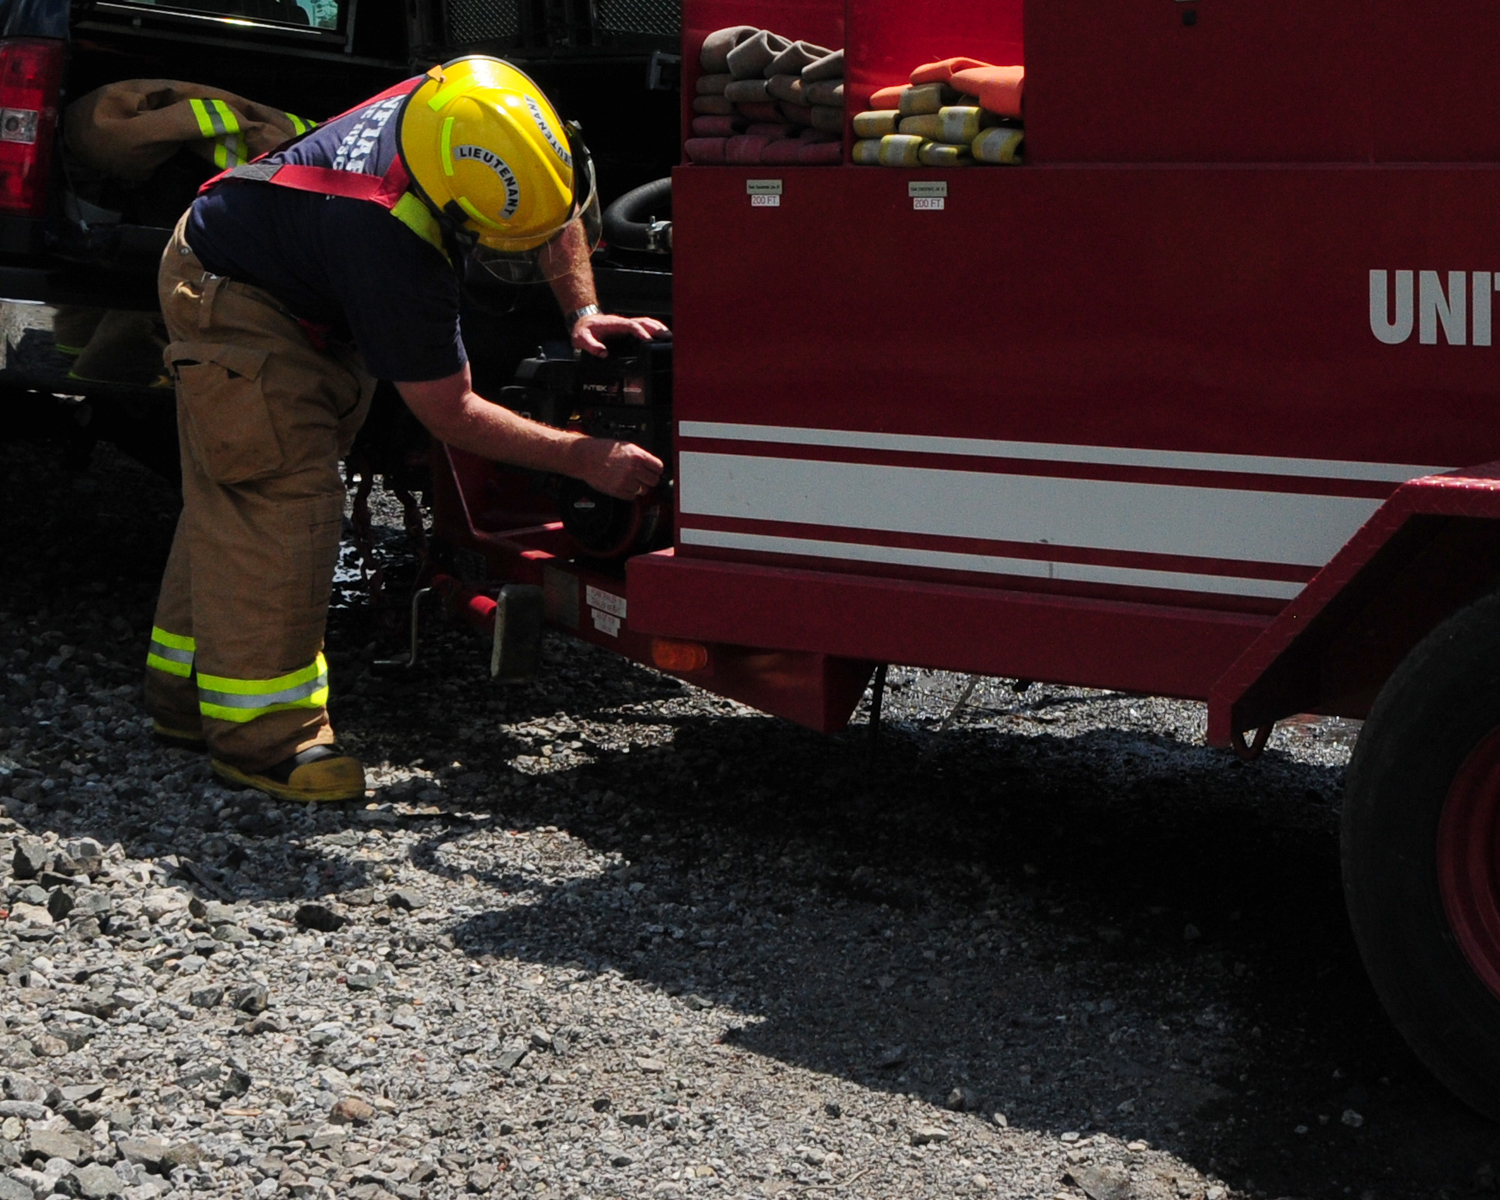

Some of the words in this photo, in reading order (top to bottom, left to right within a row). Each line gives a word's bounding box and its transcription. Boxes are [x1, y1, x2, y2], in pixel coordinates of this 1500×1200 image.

[459, 147, 516, 217] LIEUTENANT
[752, 196, 766, 205] 200
[914, 199, 929, 208] 200
